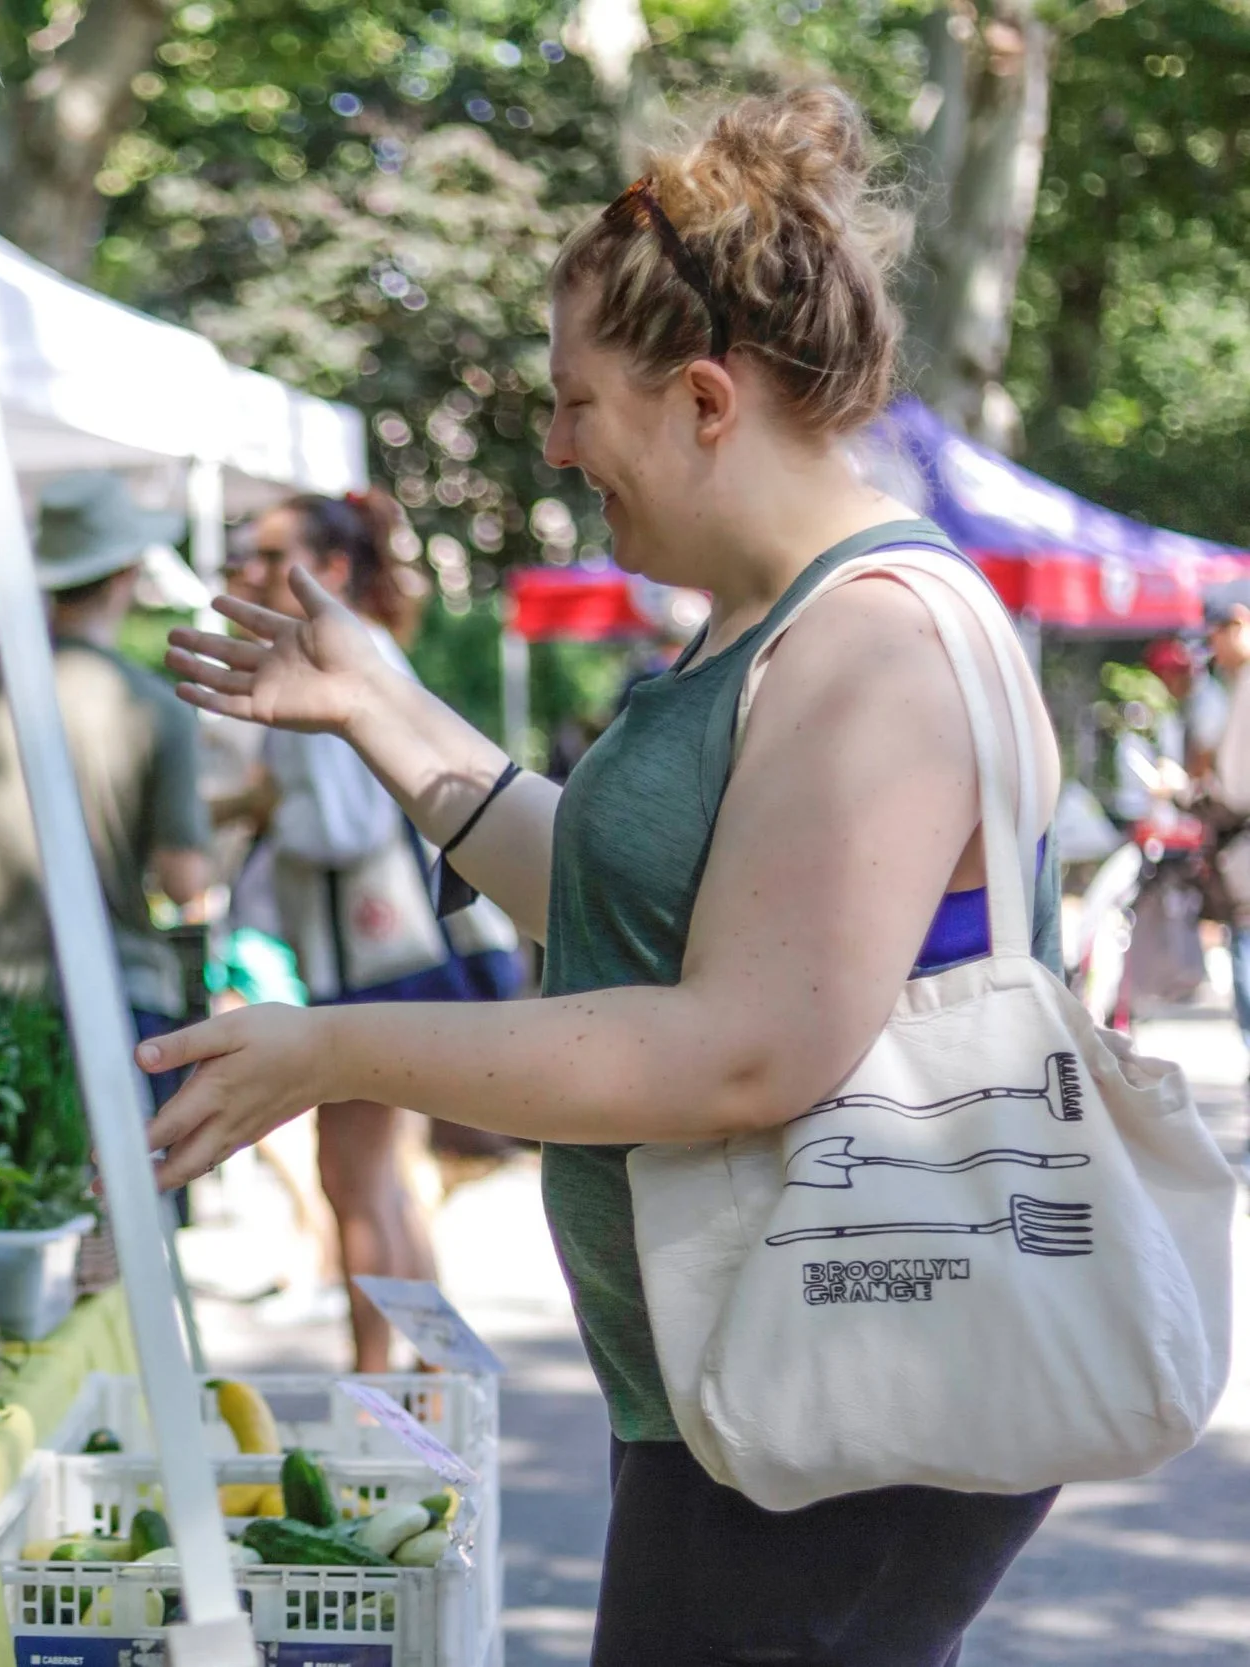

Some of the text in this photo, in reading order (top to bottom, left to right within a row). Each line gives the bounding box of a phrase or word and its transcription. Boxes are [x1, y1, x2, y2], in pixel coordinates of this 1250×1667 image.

[803, 1258, 970, 1284] BROOKLYN
[803, 1281, 932, 1305] GRANGE
[41, 1655, 84, 1665] CABERNET
